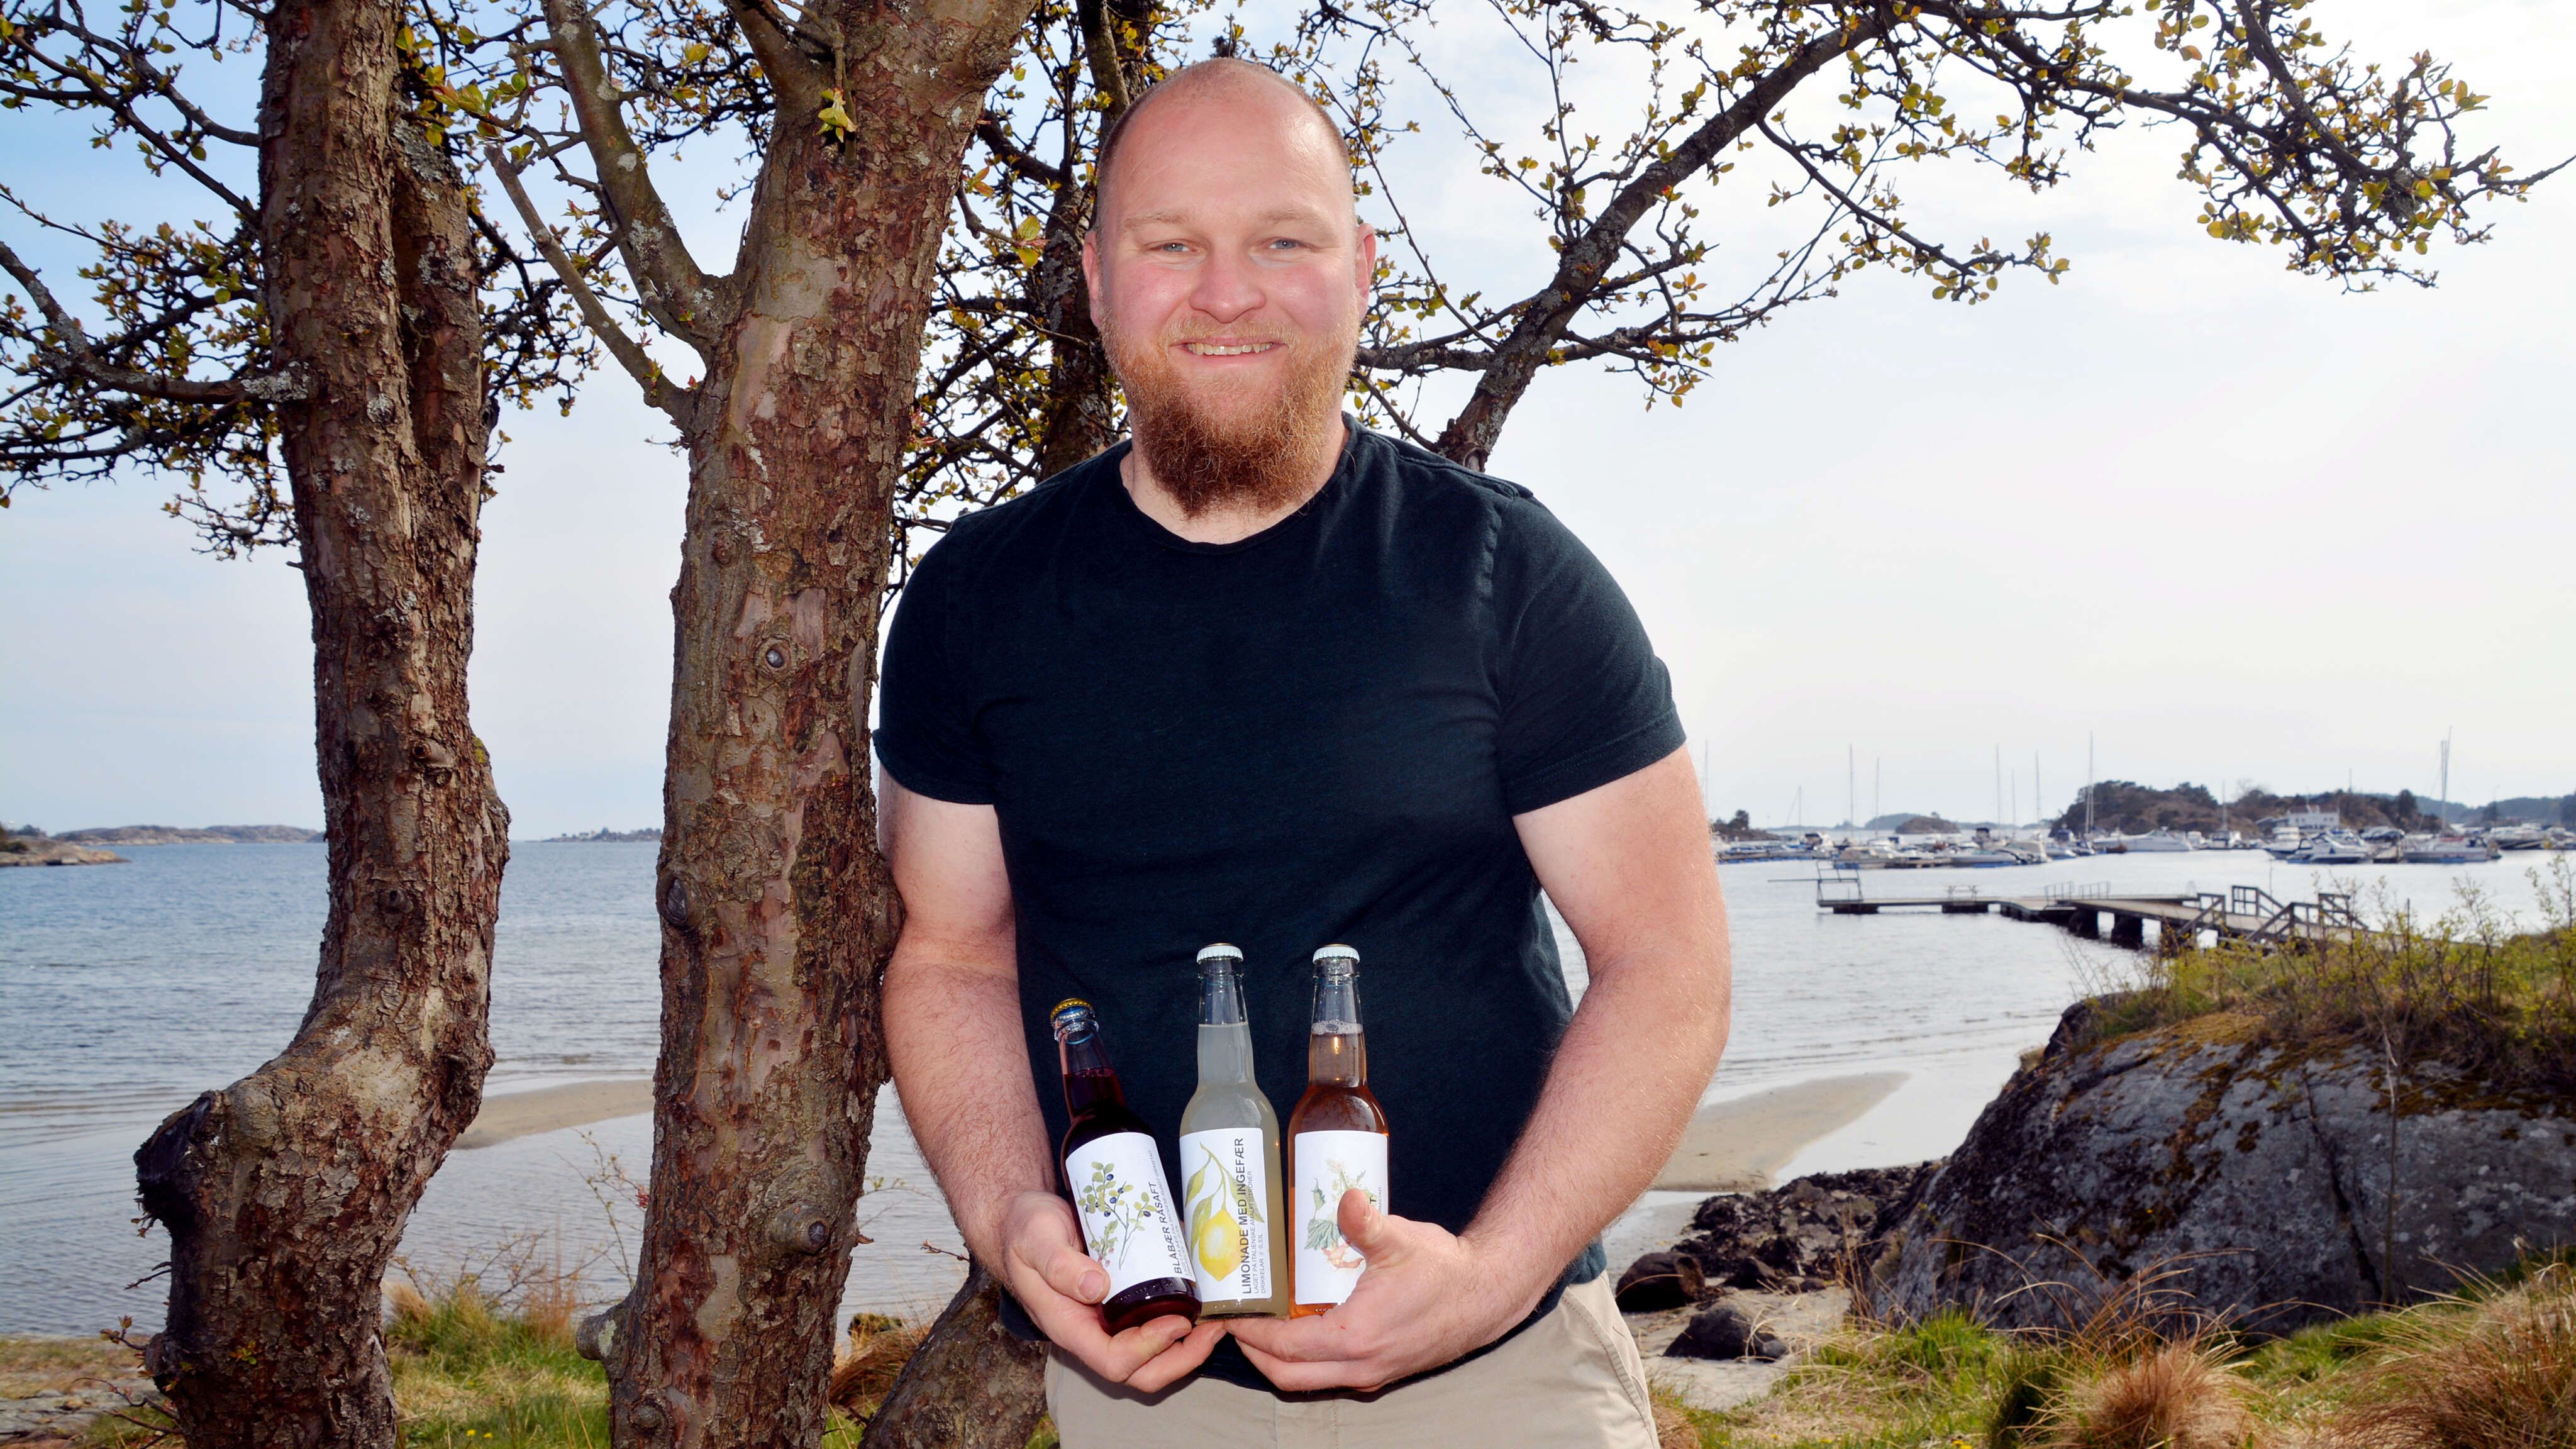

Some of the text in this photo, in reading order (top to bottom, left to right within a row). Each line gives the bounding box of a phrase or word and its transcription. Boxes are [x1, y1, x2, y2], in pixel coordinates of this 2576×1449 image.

[1235, 1138, 1251, 1294] LIMONADE MED INGEFÆR
